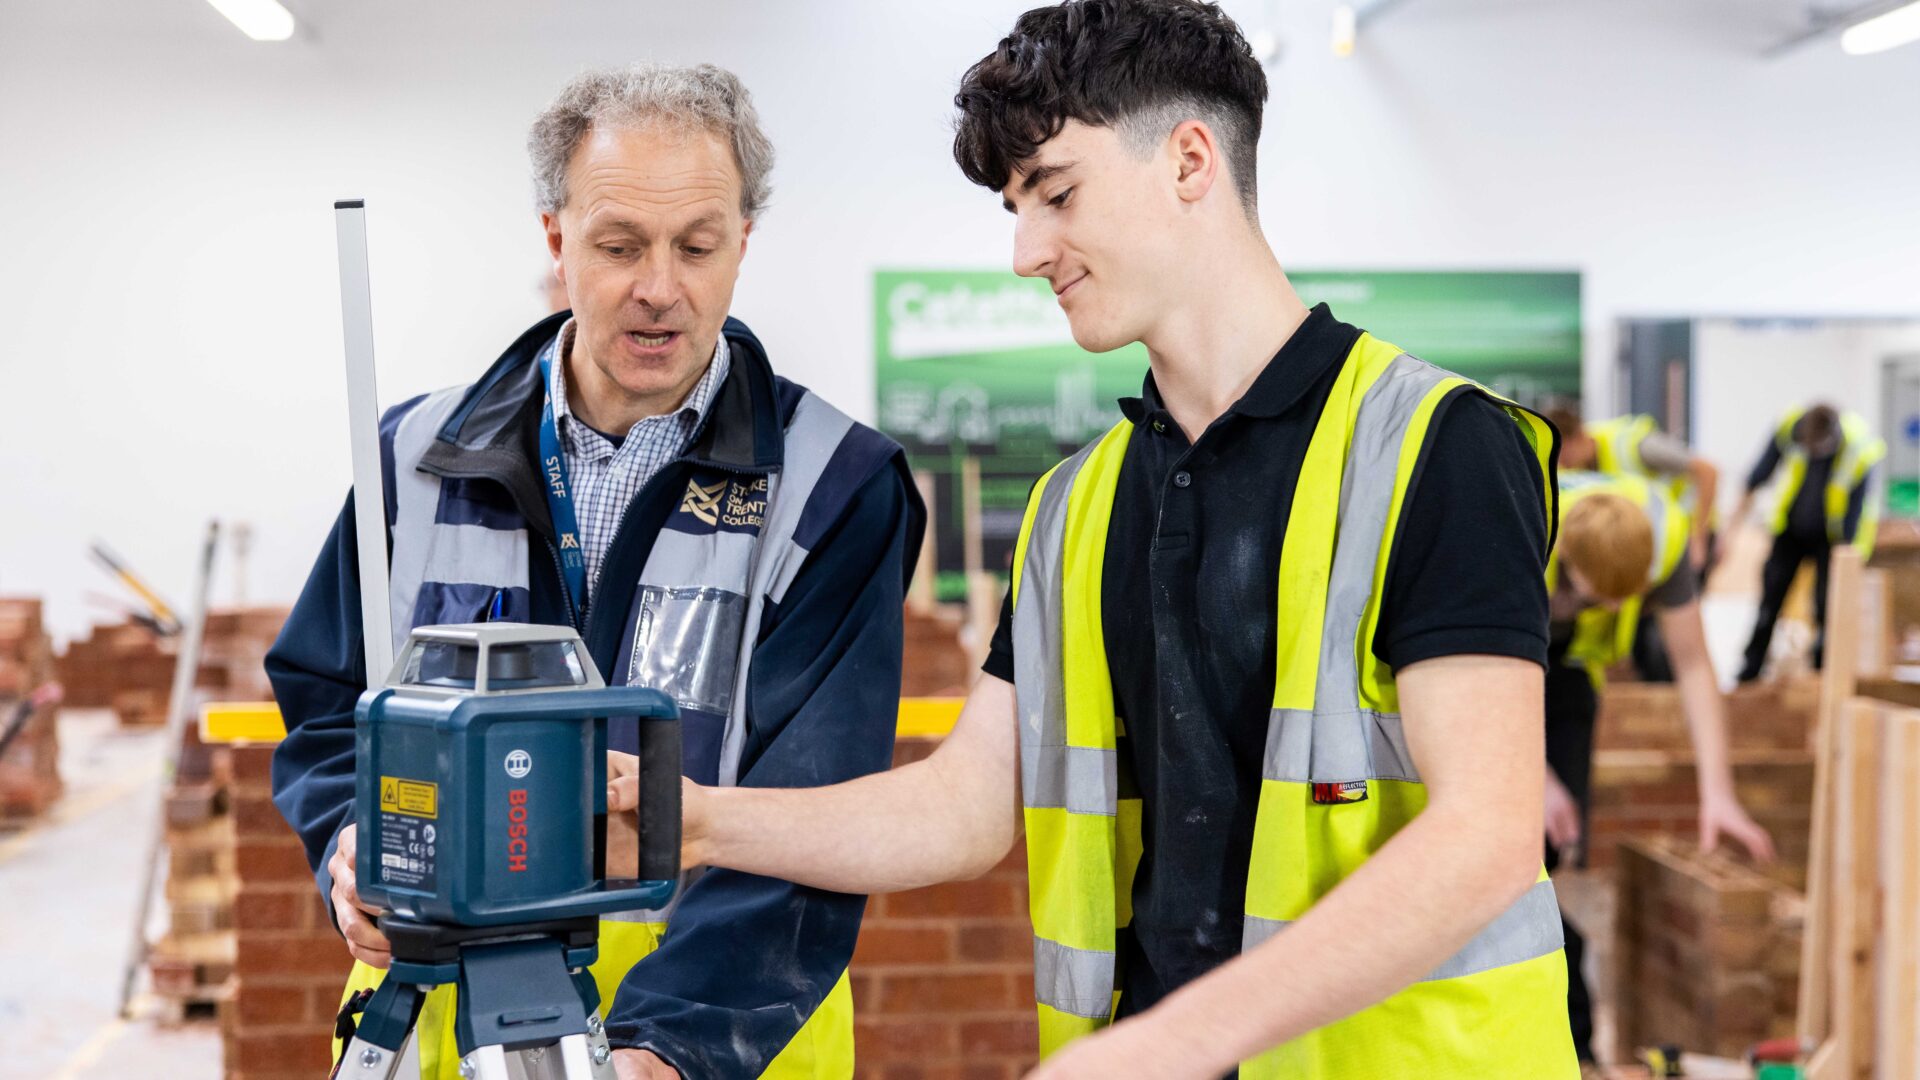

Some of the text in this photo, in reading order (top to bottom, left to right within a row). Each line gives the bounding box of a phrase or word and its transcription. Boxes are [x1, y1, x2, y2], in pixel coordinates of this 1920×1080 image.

[546, 456, 566, 498] STAFF
[726, 501, 767, 516] TRENT
[729, 494, 743, 505] ON
[508, 789, 528, 871] BOSCH
